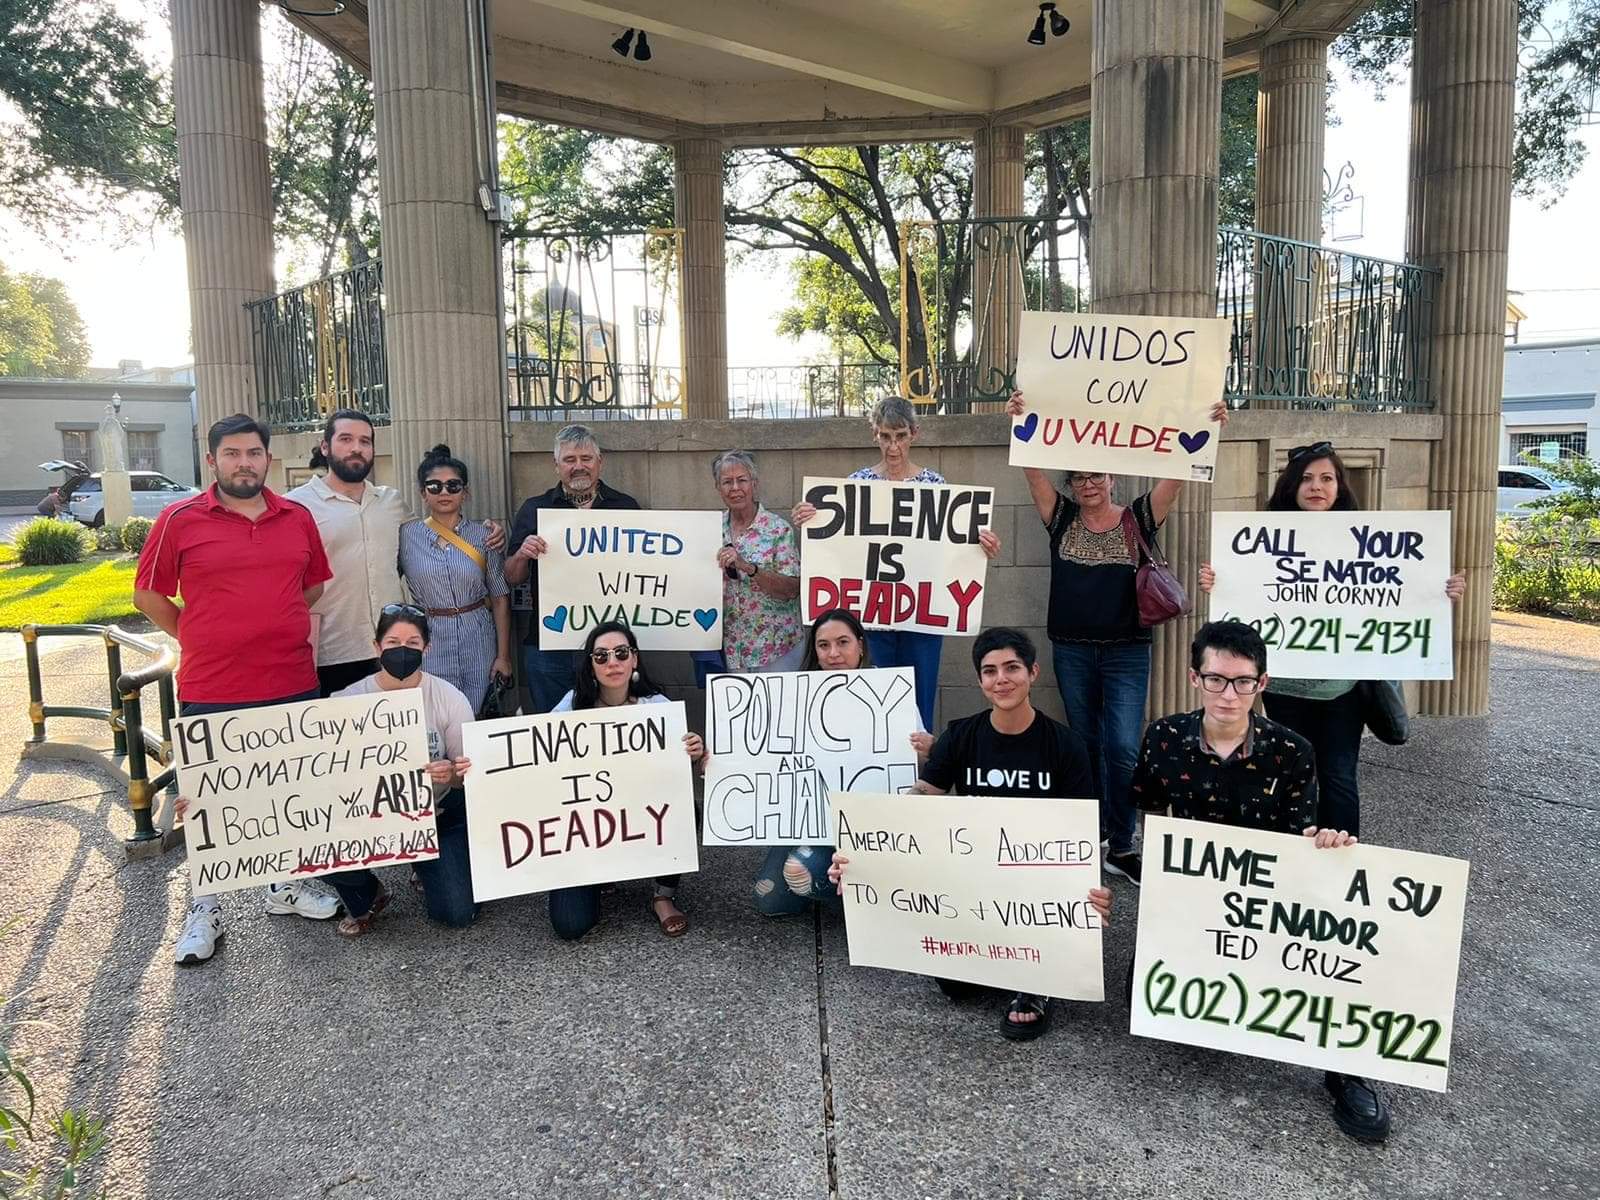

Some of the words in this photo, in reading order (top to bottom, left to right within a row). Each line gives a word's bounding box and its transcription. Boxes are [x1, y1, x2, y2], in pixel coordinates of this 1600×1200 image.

[1051, 325, 1195, 366] UNIDOS
[1087, 378, 1148, 404] CON
[1042, 418, 1180, 453] UVALDE
[805, 484, 992, 545] SILENCE
[566, 526, 684, 557] UNITED
[866, 542, 906, 582] IS
[1231, 526, 1306, 557] CALL
[1350, 525, 1424, 561] YOUR
[598, 571, 668, 597] WITH
[1263, 583, 1318, 604] JOHN
[1325, 585, 1402, 607] CORNYN
[1275, 557, 1403, 586] SENATOR
[568, 603, 691, 631] UVALDE
[808, 576, 983, 632] DEADLY
[1222, 611, 1432, 658] 2)224-2934
[174, 718, 217, 767] 19
[221, 712, 295, 753] Good
[300, 705, 347, 745] Guy
[373, 699, 418, 735] Gun
[711, 674, 913, 756] POLICY
[197, 765, 242, 798] NO
[246, 750, 350, 790] MATCH
[360, 740, 408, 770] FOR
[485, 717, 665, 774] INACTION
[778, 755, 815, 772] AND
[561, 770, 613, 805] IS
[966, 767, 971, 786] I
[976, 767, 1031, 789] LOVE
[1038, 771, 1051, 790] U
[191, 808, 216, 851] 1
[222, 799, 280, 846] Bad
[284, 794, 332, 833] Guy
[500, 803, 670, 869] DEADLY
[837, 809, 922, 855] AMERICA
[949, 827, 974, 855] IS
[997, 827, 1094, 863] ADDICTED
[199, 860, 231, 887] NO
[234, 850, 293, 878] MORE
[297, 836, 388, 869] WEAPONS
[400, 827, 437, 856] WAR
[1162, 833, 1277, 889] LLAME
[1345, 869, 1370, 906] A
[1387, 876, 1442, 918] SU
[847, 883, 878, 905] TO
[891, 888, 959, 920] GUNS
[992, 900, 1101, 930] VIOLENCE
[1222, 891, 1379, 956] SENADOR
[1205, 928, 1258, 960] TED
[1281, 941, 1363, 985] CRUZ
